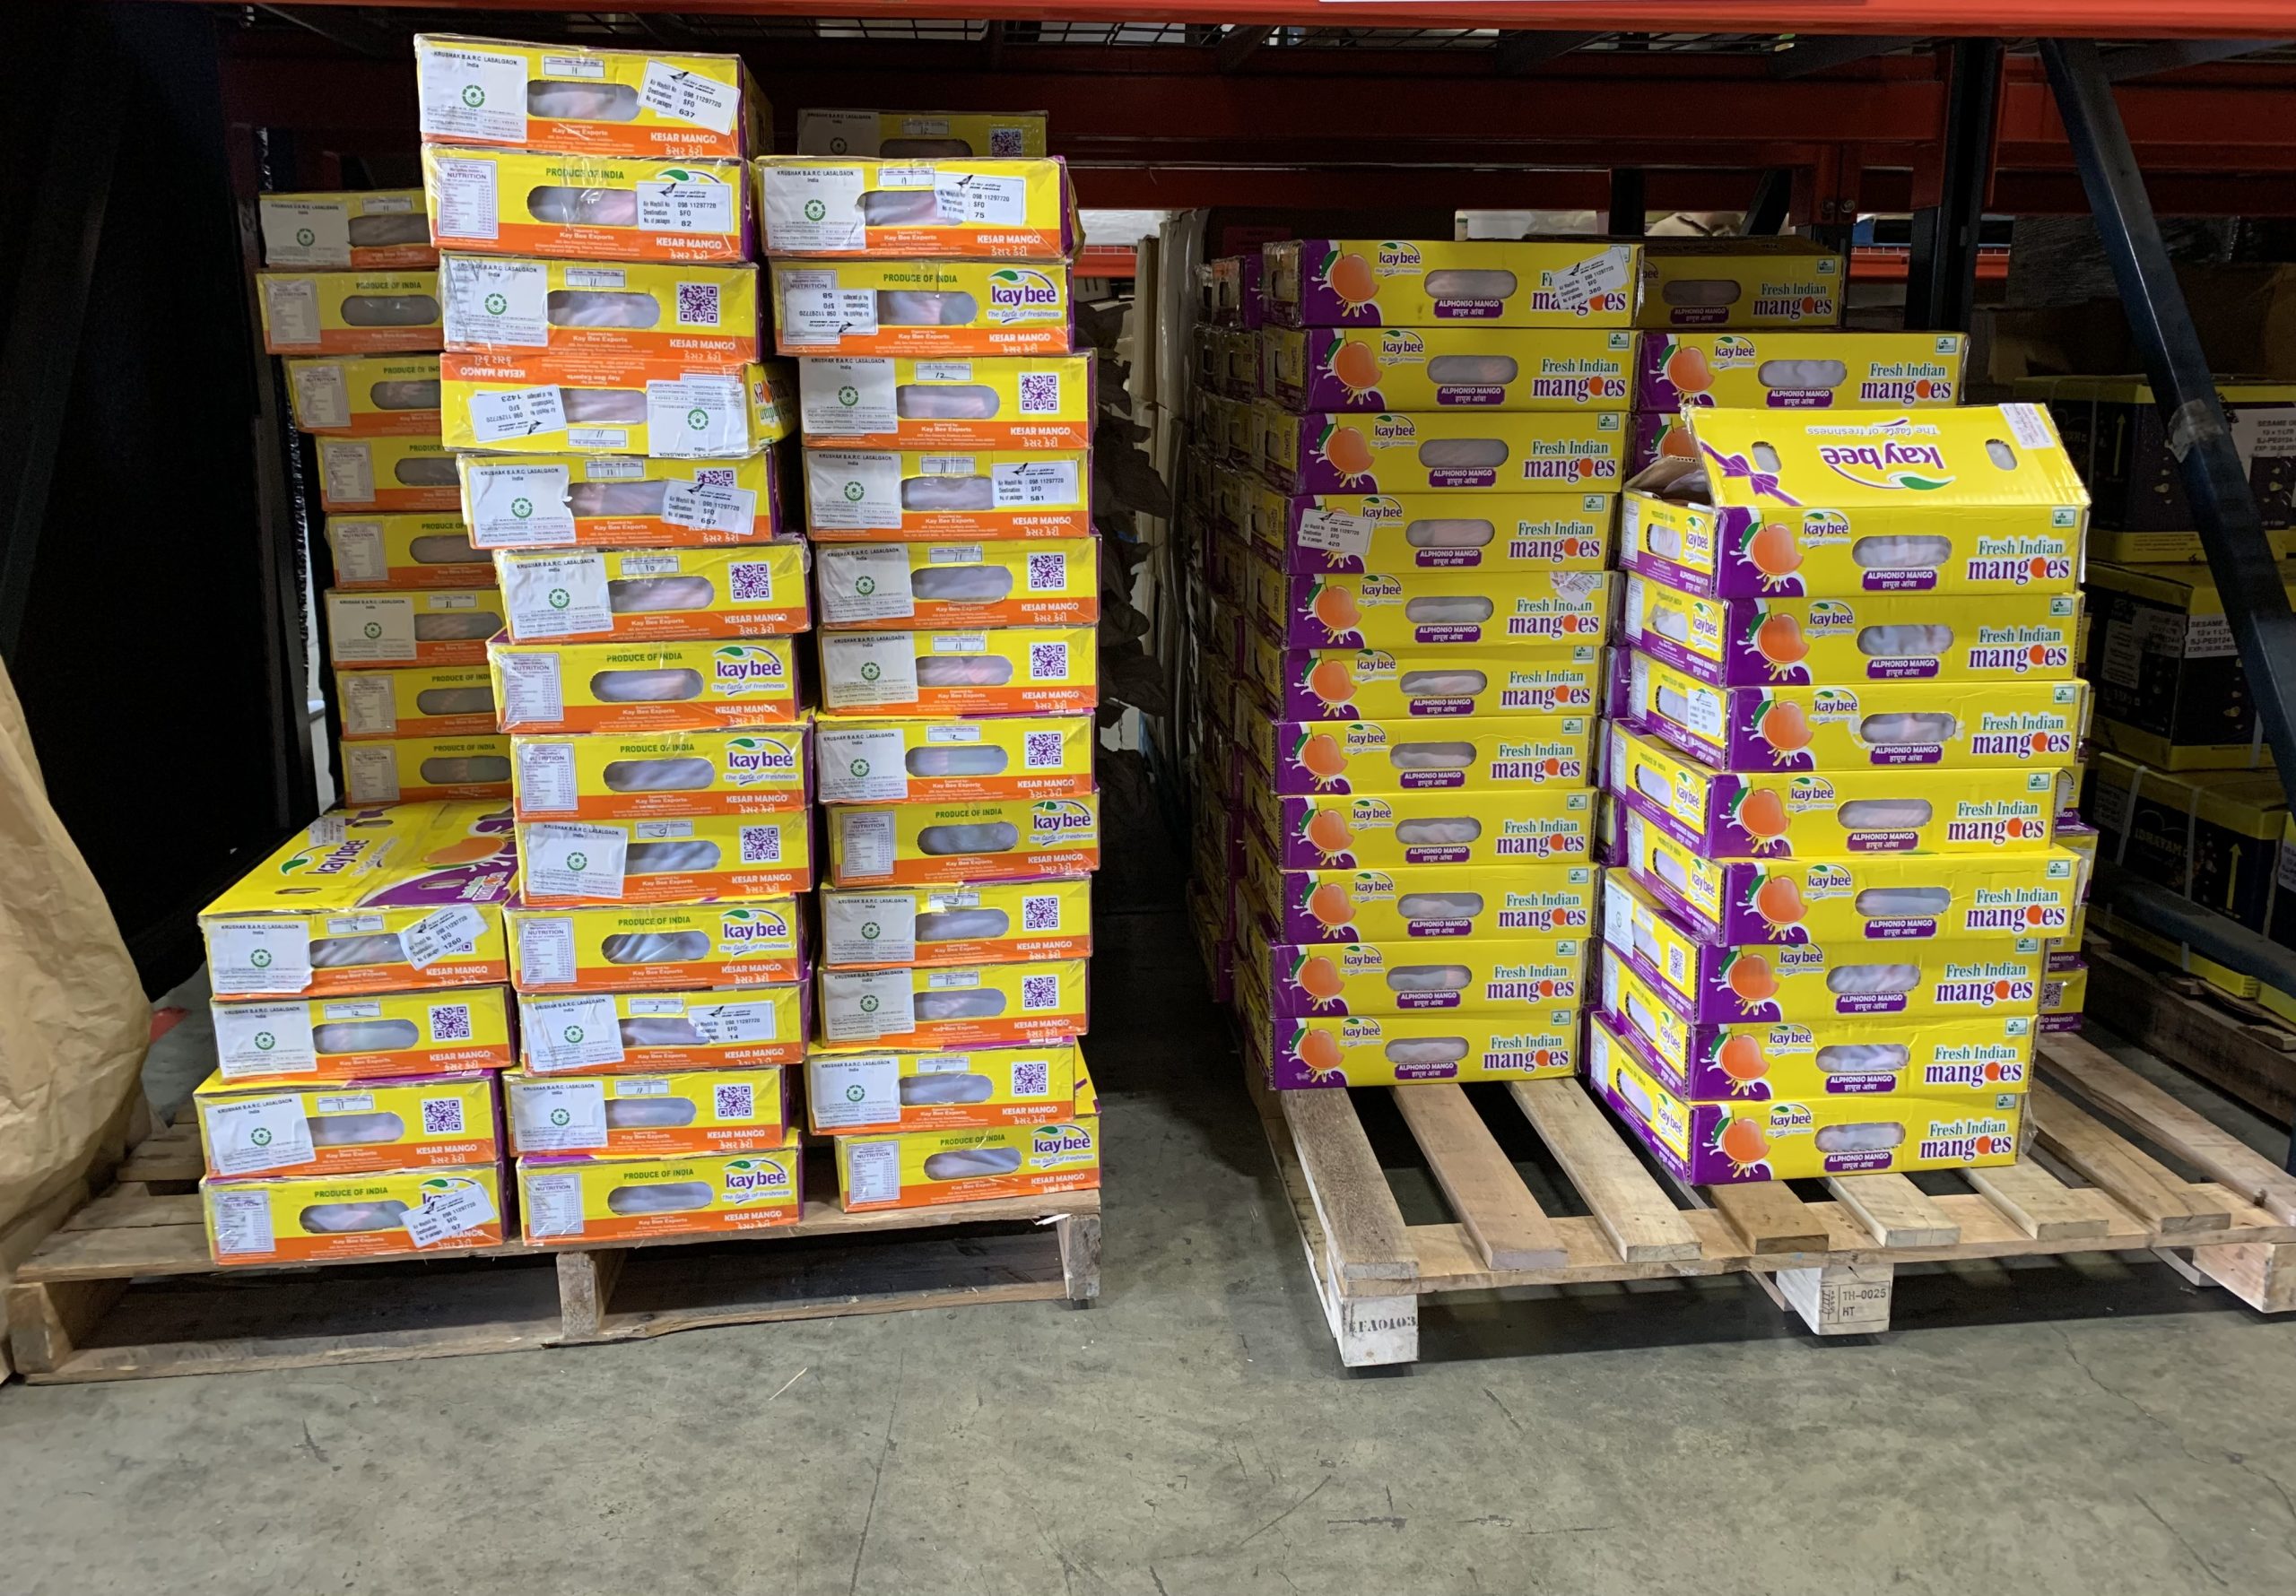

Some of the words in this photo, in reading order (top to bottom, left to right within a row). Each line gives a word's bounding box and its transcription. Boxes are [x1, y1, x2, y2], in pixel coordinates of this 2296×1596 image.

[679, 108, 695, 117] 637
[650, 133, 679, 143] KESAR
[682, 134, 717, 143] MANGO
[657, 237, 684, 247] KESAR
[687, 238, 722, 249] MANGO
[978, 234, 1004, 244] KESAR
[1005, 235, 1040, 244] MANGO
[883, 273, 920, 282] PRODUCE
[923, 274, 934, 282] OF
[936, 274, 957, 283] INDIA
[1761, 283, 1789, 296] Fresh
[1793, 282, 1827, 295] Indian
[670, 340, 698, 349] KESAR
[701, 341, 735, 350] MANGO
[1542, 360, 1574, 372] Fresh
[1578, 360, 1619, 372] Indian
[460, 367, 493, 376] MANGO
[496, 369, 526, 377] KESAR
[1010, 427, 1036, 435] KESAR
[1039, 427, 1070, 435] MANGO
[1807, 427, 1863, 435] freshness
[1869, 426, 1878, 435] of
[1013, 516, 1038, 525] KESAR
[1039, 516, 1071, 525] MANGO
[1979, 541, 2014, 555] Fresh
[2019, 540, 2064, 554] Indian
[1906, 570, 1932, 578] MANGO
[1022, 603, 1048, 612] KESAR
[1049, 603, 1079, 611] MANGO
[725, 614, 751, 623] KESAR
[753, 613, 787, 622] MANGO
[1979, 629, 2014, 643] Fresh
[2018, 629, 2060, 642] Indian
[606, 653, 645, 663] PRODUCE
[648, 653, 658, 662] OF
[660, 652, 682, 661] INDIA
[621, 744, 657, 752] PRODUCE
[672, 743, 695, 752] INDIA
[726, 794, 752, 803] KESAR
[753, 794, 787, 803] MANGO
[935, 810, 968, 819] PRODUCE
[982, 809, 1003, 817] INDIA
[732, 875, 756, 883] KESAR
[759, 873, 792, 882] MANGO
[618, 918, 653, 926] PRODUCE
[656, 917, 665, 925] OF
[668, 915, 691, 924] INDIA
[444, 937, 461, 949] 1260
[426, 967, 453, 976] KESAR
[455, 966, 488, 975] MANGO
[725, 1049, 751, 1059] KESAR
[752, 1048, 784, 1057] MANGO
[1929, 1124, 1962, 1136] Fresh
[1966, 1123, 2005, 1134] Indian
[416, 1146, 442, 1155] KESAR
[444, 1145, 477, 1154] MANGO
[624, 1170, 658, 1179] PRODUCE
[661, 1170, 671, 1178] OF
[673, 1168, 694, 1177] INDIA
[1031, 1176, 1054, 1184] KESAR
[1056, 1174, 1084, 1184] MANGO
[315, 1189, 351, 1198] PRODUCE
[352, 1189, 363, 1197] OF
[365, 1186, 388, 1195] INDIA
[1843, 1288, 1886, 1300] TH-0025
[1843, 1307, 1855, 1316] HT
